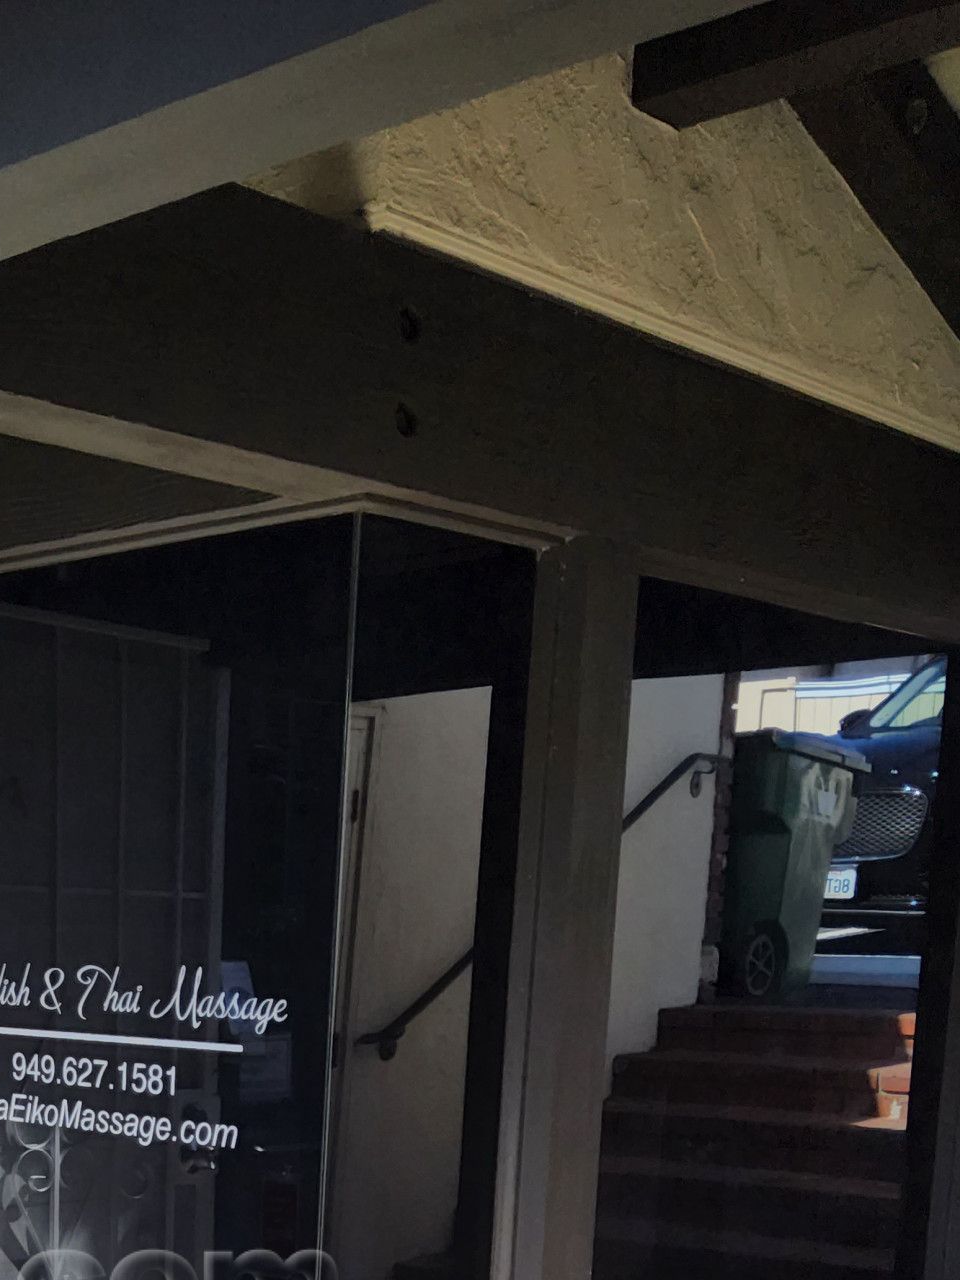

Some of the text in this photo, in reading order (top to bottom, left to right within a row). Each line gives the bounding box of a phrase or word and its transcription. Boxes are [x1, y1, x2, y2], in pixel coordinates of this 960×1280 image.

[39, 967, 66, 1015] &
[76, 964, 144, 1020] Thai
[149, 964, 288, 1035] Massage
[11, 1052, 177, 1097] 949.627.1581
